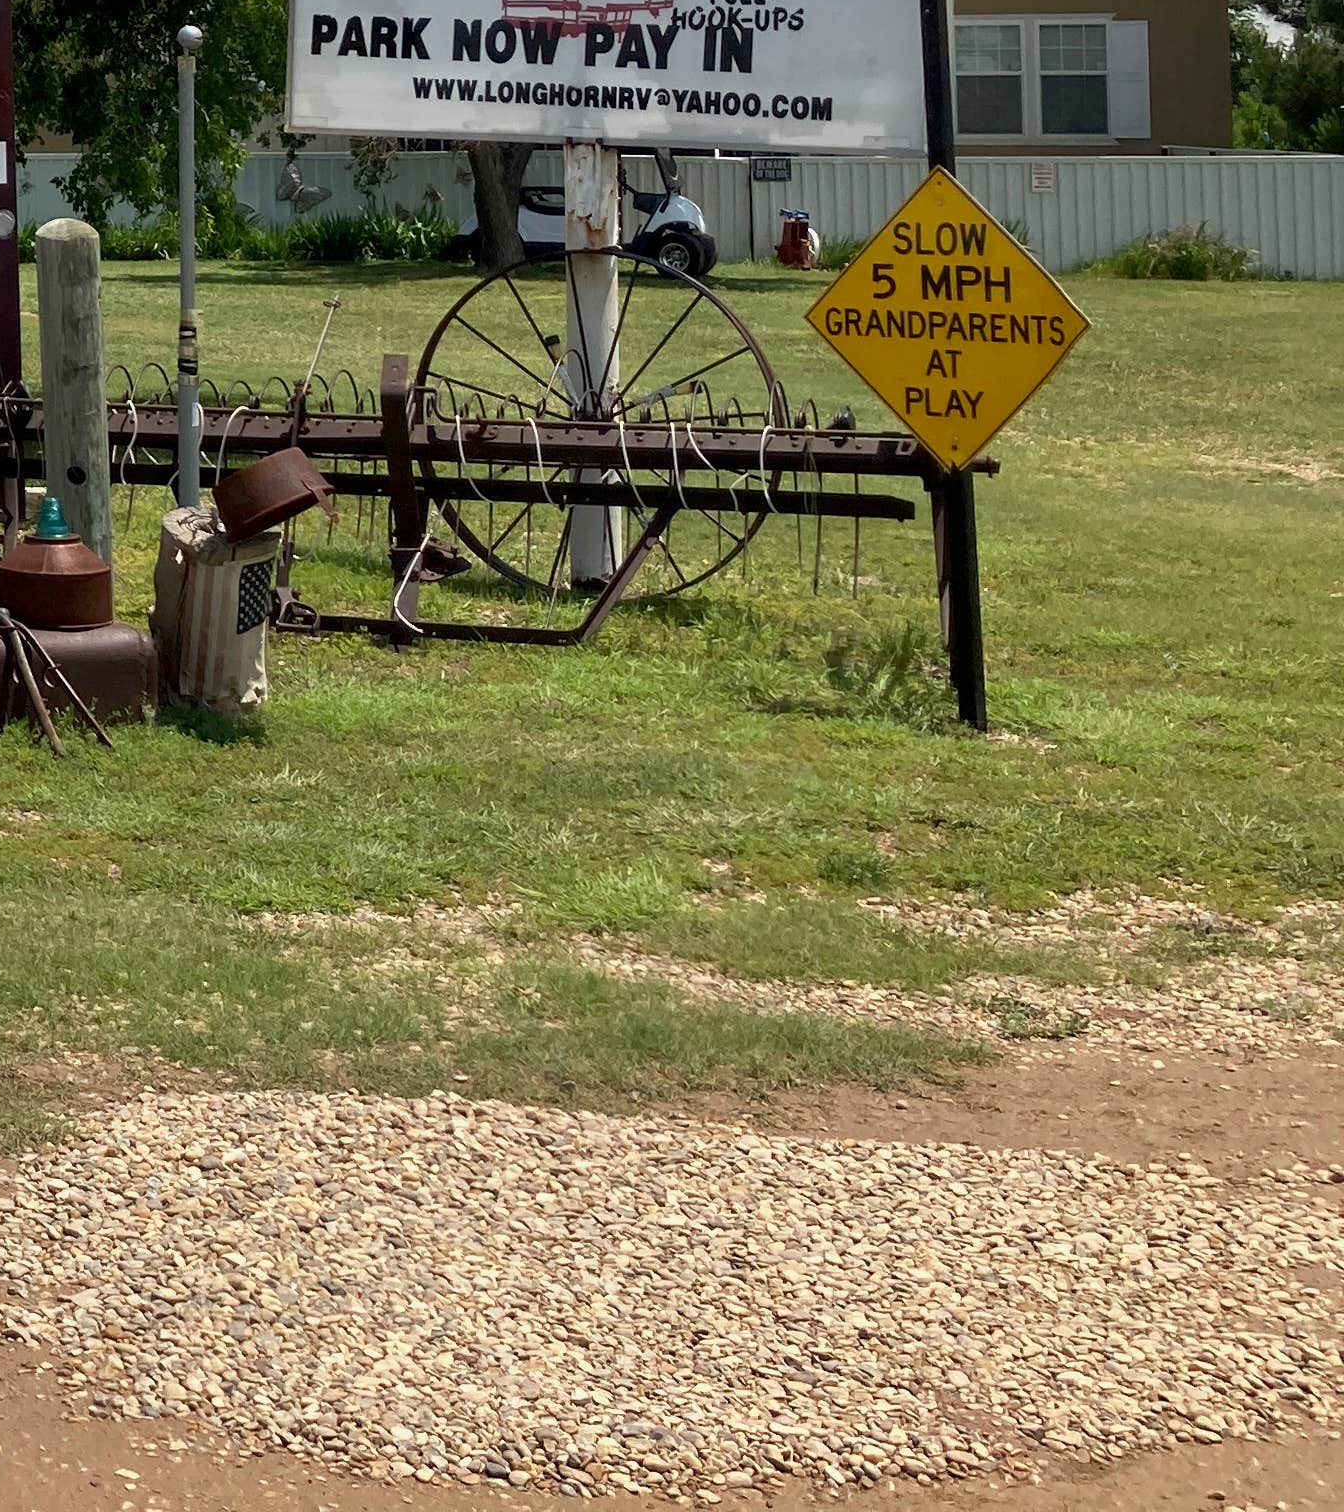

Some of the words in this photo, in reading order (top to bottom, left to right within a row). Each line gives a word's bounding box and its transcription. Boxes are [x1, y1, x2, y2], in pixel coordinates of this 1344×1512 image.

[670, 6, 805, 32] HOOK-UPS
[310, 14, 432, 61] PARK
[452, 18, 564, 66] NOW
[584, 23, 681, 70] PAY
[702, 26, 754, 74] IN
[412, 76, 833, 122] WWW.LONGHORNRV@YAHOO.COM
[893, 221, 987, 256] SLOW
[872, 263, 897, 300] 5
[920, 264, 1013, 303] MPH
[824, 307, 1066, 347] GRANDPARENTS
[926, 349, 963, 379] AT
[905, 386, 985, 420] PLAY
